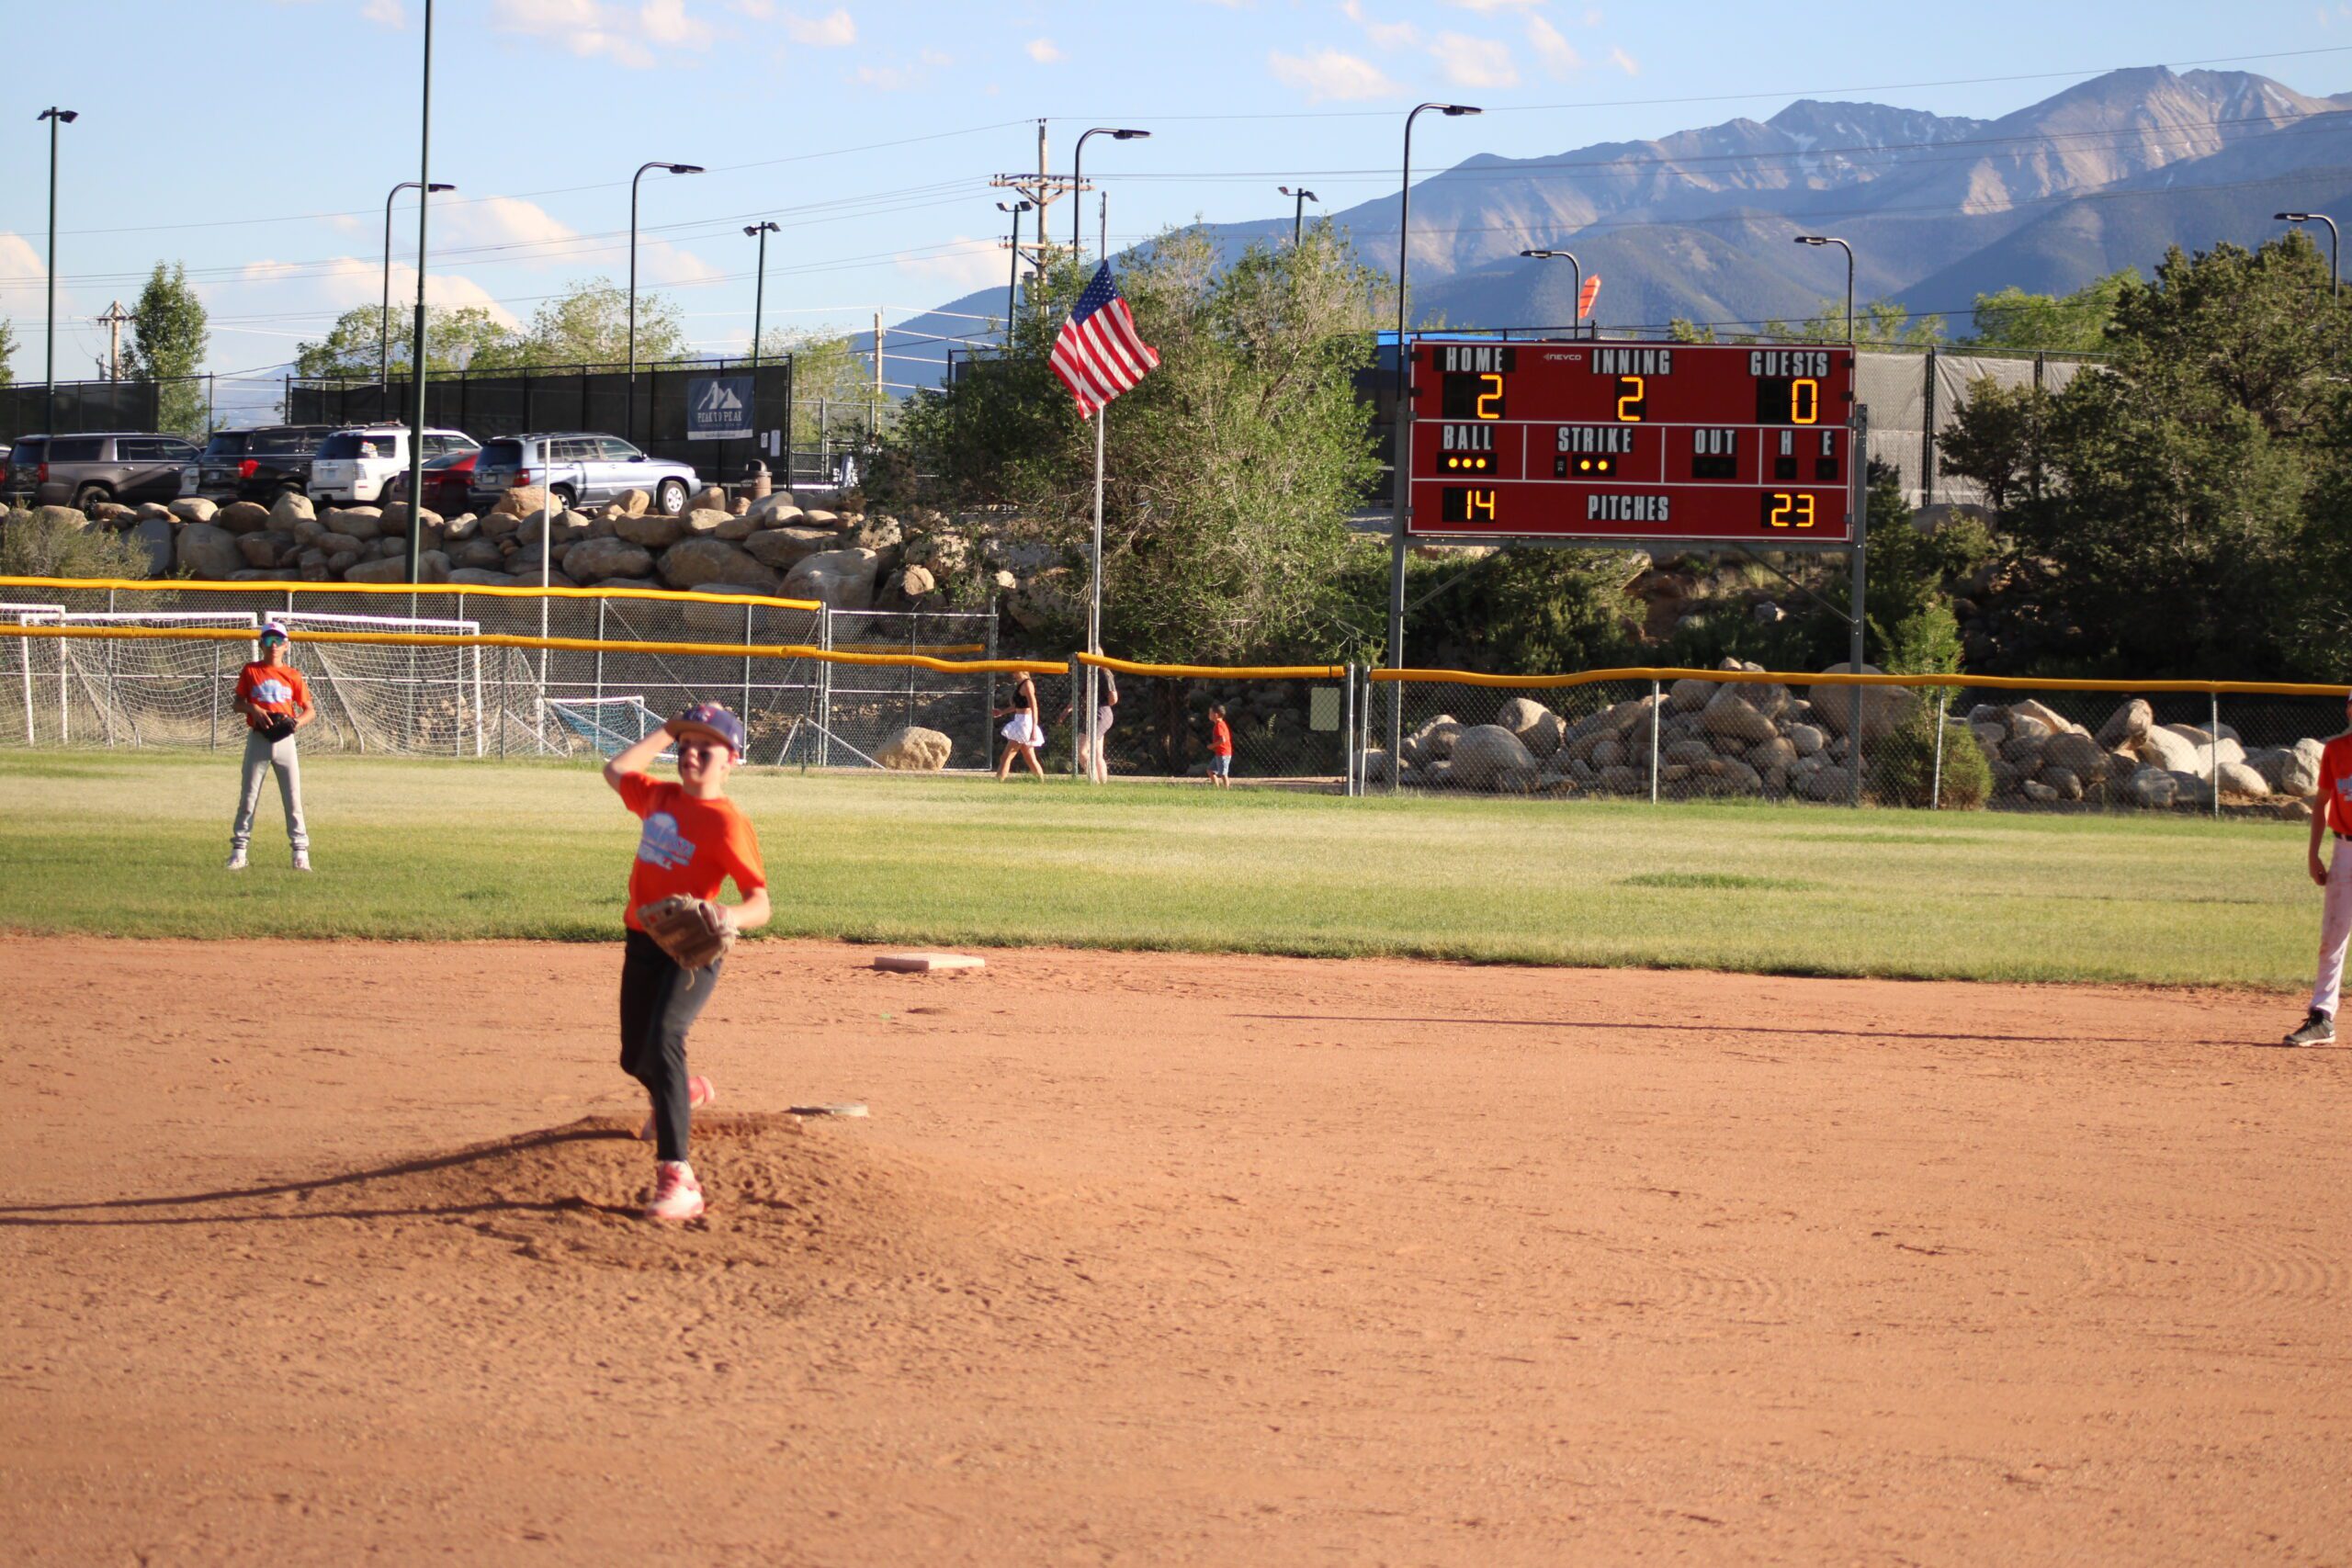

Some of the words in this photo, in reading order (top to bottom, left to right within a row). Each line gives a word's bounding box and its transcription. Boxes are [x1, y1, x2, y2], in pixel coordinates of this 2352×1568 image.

[1445, 346, 1503, 372] HOME
[1592, 349, 1671, 375] INNING
[1750, 351, 1828, 378] GUESTS
[1476, 374, 1503, 419] 2
[1617, 377, 1645, 422] 2
[1791, 378, 1818, 424] 0
[697, 412, 713, 423] PEAK
[724, 411, 742, 422] PEAK
[1442, 424, 1492, 451] BALL
[1557, 426, 1632, 453] STRIKE
[1694, 429, 1736, 455] OUT
[1781, 430, 1792, 456] H
[1822, 430, 1832, 456] E
[1466, 490, 1495, 521] 14
[1587, 494, 1669, 522] PITCHES
[1770, 493, 1815, 527] 23
